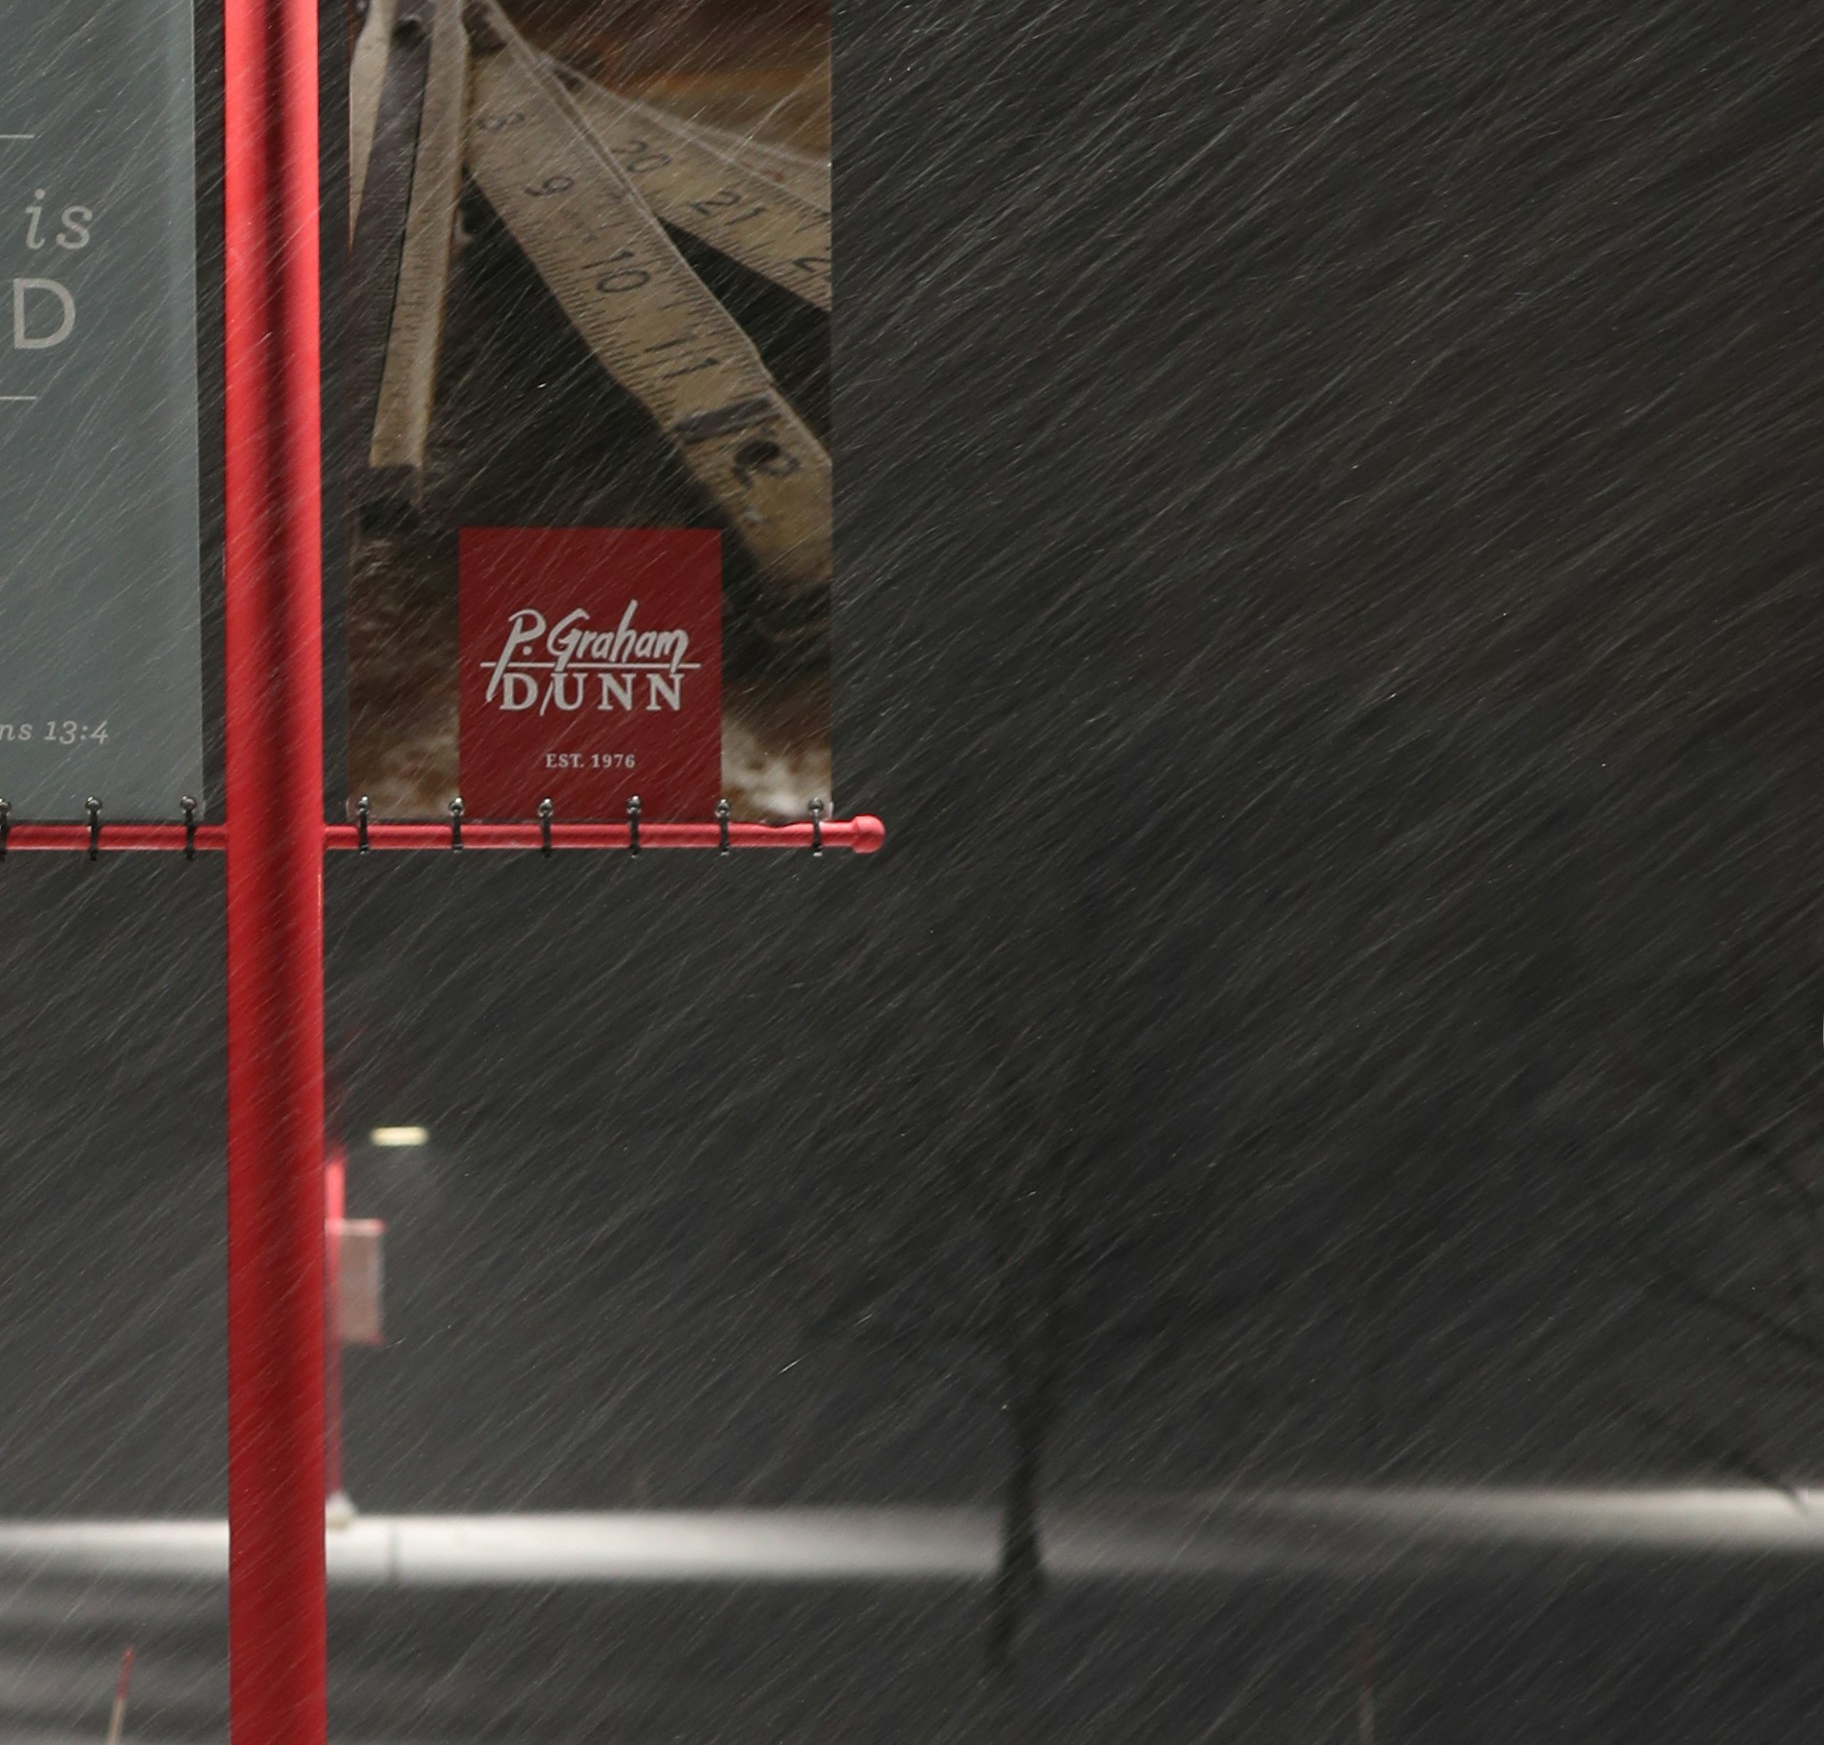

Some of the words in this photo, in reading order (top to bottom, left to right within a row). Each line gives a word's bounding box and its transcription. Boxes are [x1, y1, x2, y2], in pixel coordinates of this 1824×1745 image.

[24, 188, 94, 250] is
[690, 189, 767, 228] 21
[581, 250, 652, 294] 10
[485, 608, 547, 703] P.
[543, 599, 690, 694] Graham
[499, 672, 685, 712] DUNN
[43, 719, 110, 745] 13:4
[545, 753, 585, 769] EST.
[591, 753, 636, 769] 1976
